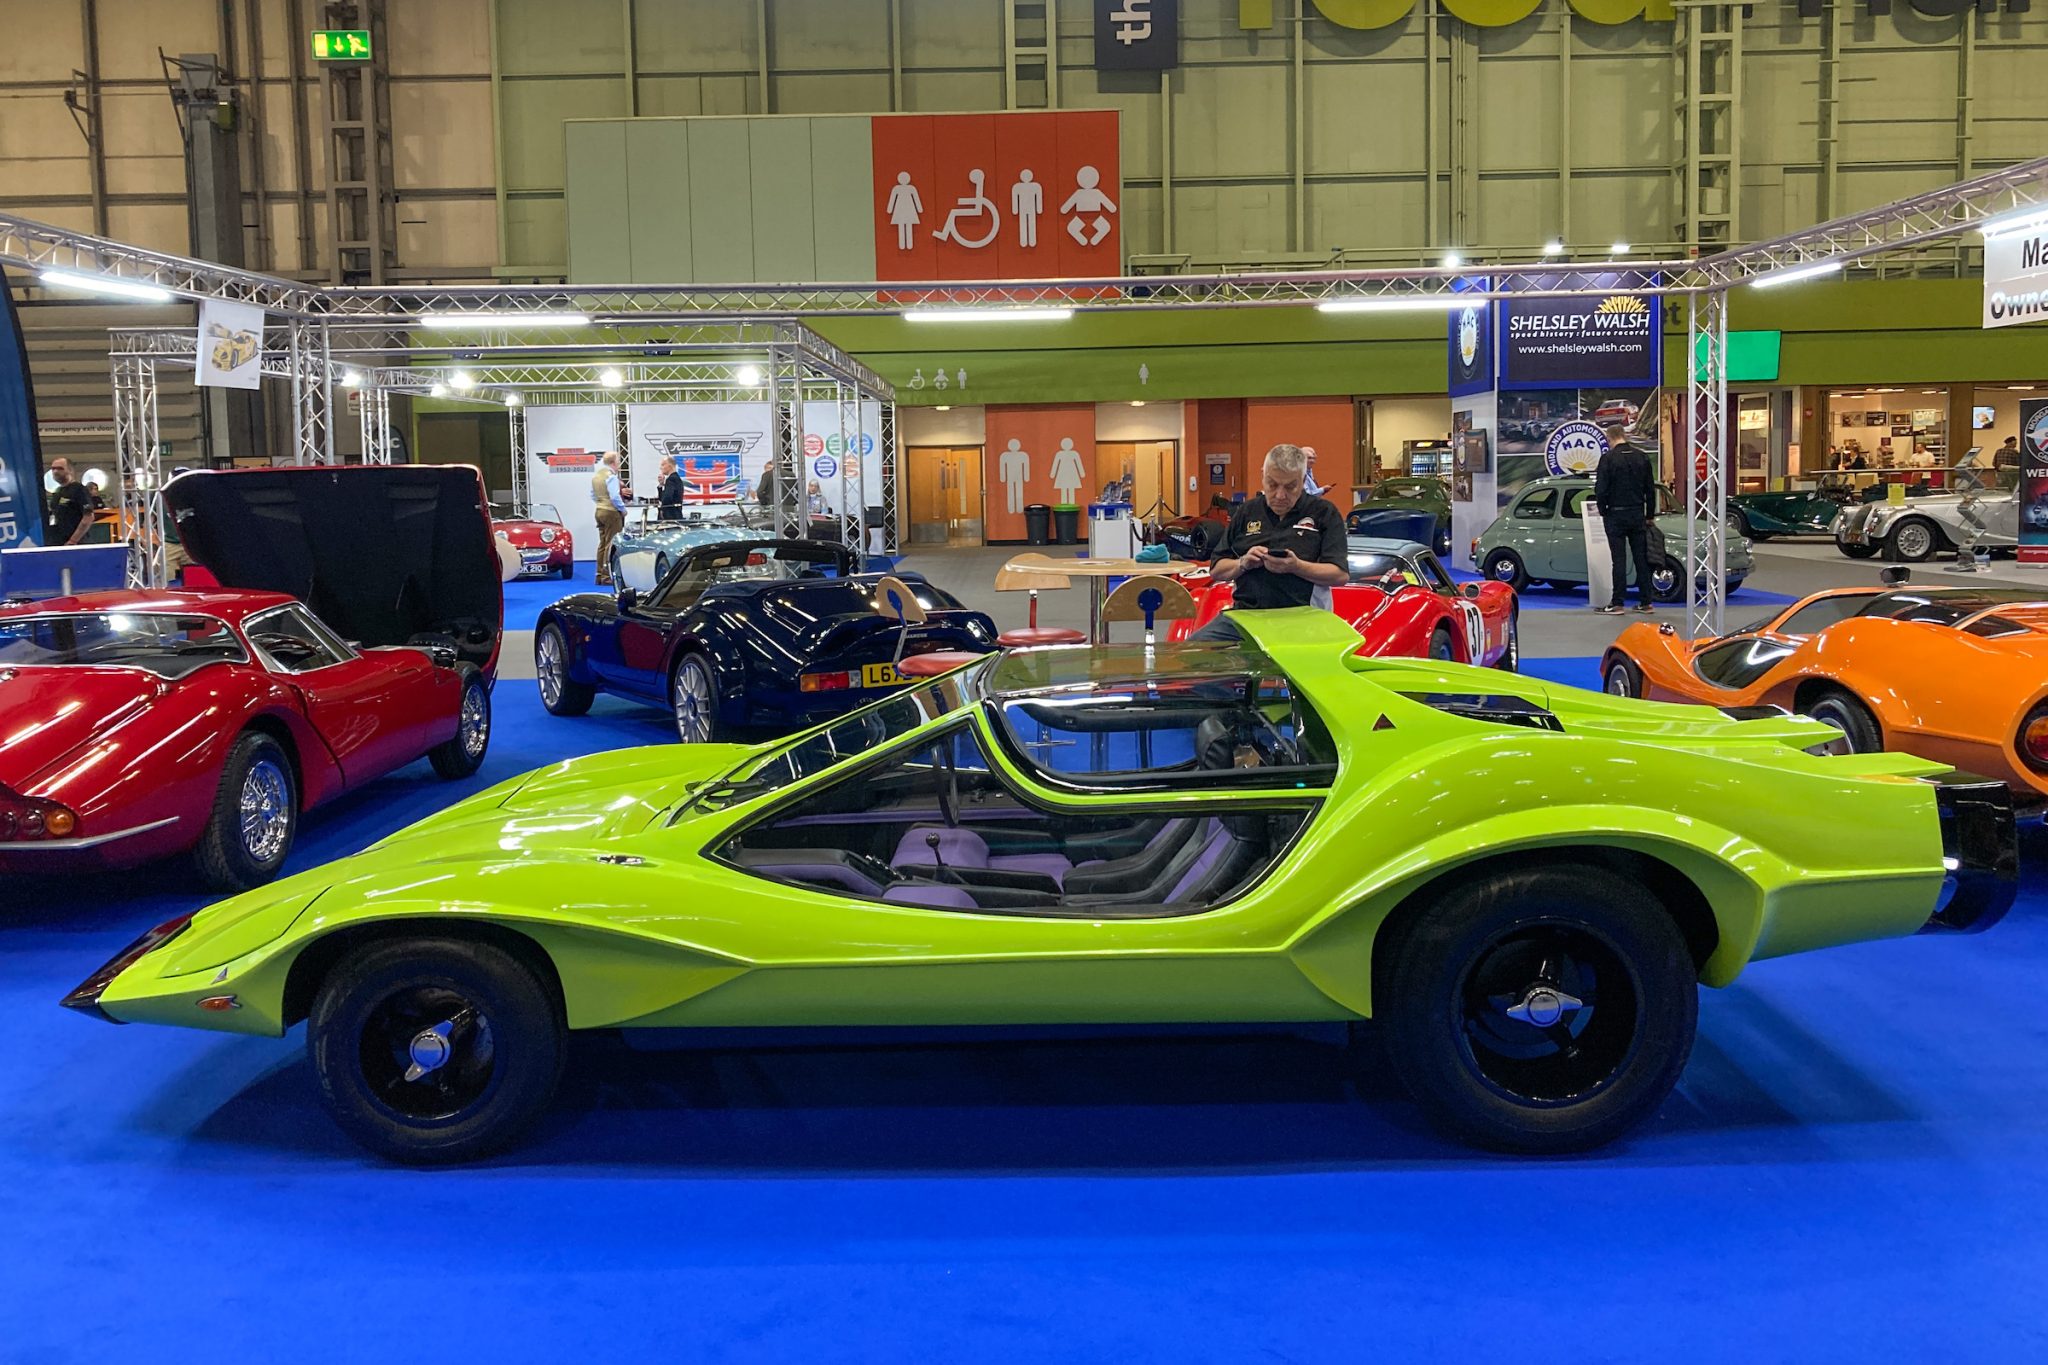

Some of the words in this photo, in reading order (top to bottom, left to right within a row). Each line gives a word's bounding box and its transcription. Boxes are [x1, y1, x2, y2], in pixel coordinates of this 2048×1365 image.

[1510, 314, 1591, 331] SHELSLEY
[1594, 313, 1650, 329] WALSH
[1510, 330, 1538, 340] speed
[1540, 330, 1574, 339] history
[1581, 329, 1612, 338] future
[1613, 328, 1650, 337] records
[1518, 343, 1643, 355] www.shelsleywalsh.com
[670, 442, 705, 452] Austin
[707, 441, 740, 452] Healey
[1548, 434, 1562, 469] MIDLAND
[1562, 424, 1608, 446] AUTOMOBILE
[1561, 438, 1597, 451] MAC
